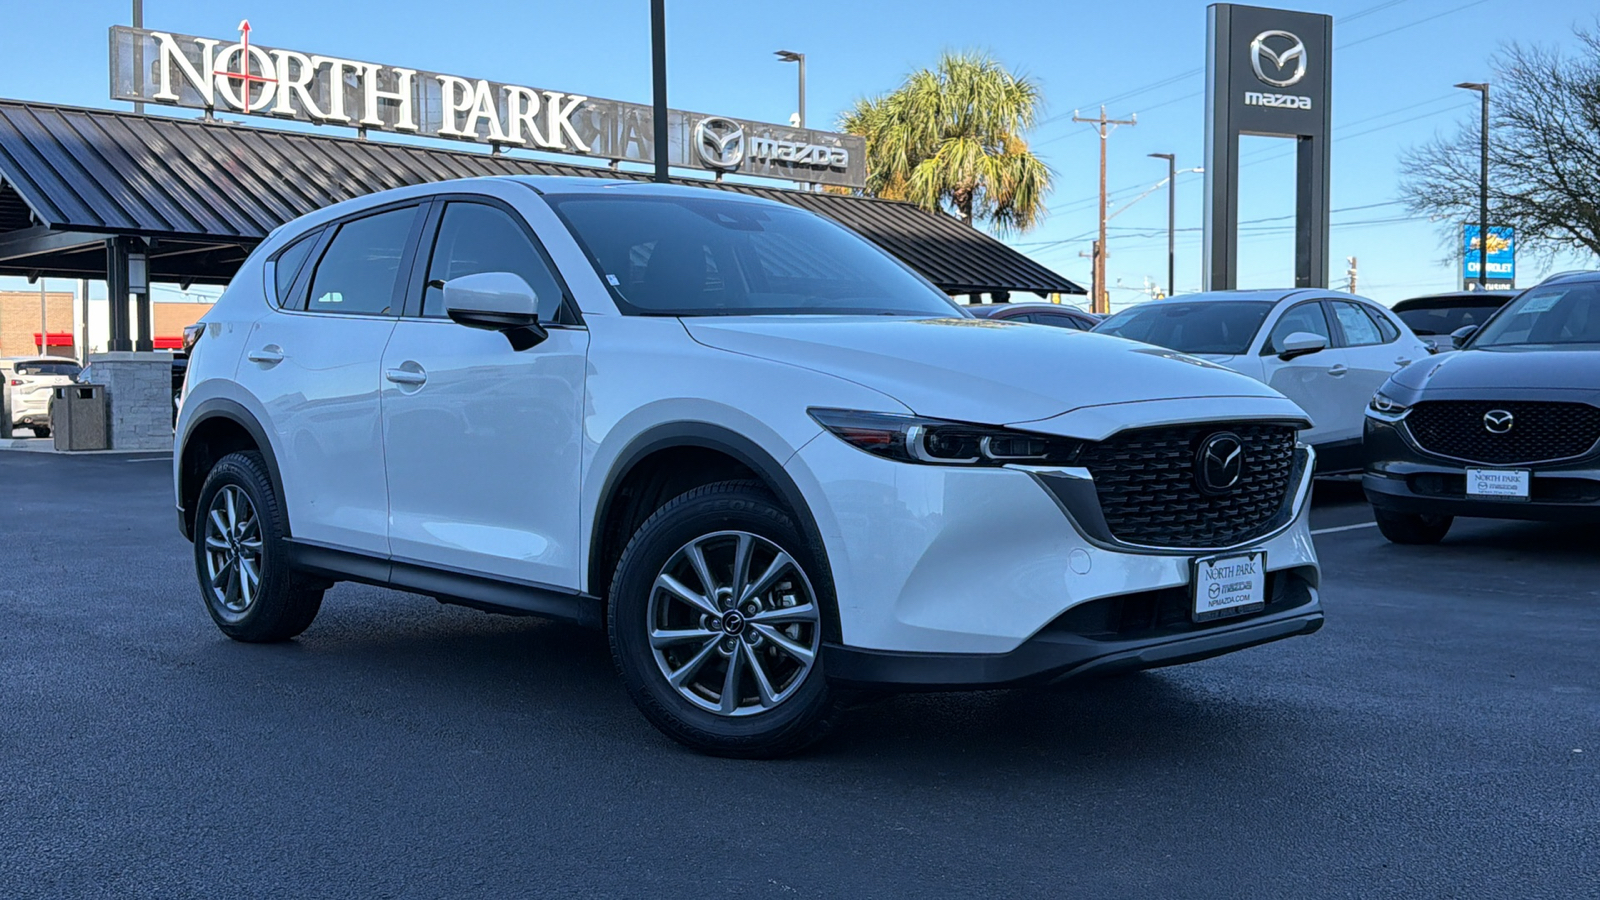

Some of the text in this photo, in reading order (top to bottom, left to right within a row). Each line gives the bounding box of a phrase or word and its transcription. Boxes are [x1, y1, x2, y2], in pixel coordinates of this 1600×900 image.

[151, 31, 419, 132] NORTH
[436, 75, 591, 152] PARK
[1244, 91, 1312, 110] mazda
[748, 136, 849, 169] mazda
[1468, 262, 1512, 273] CHROLET
[1475, 474, 1500, 482] NORTH
[1205, 562, 1256, 581] NORTH PARK
[1208, 594, 1250, 607] NPMAZDA.COM
